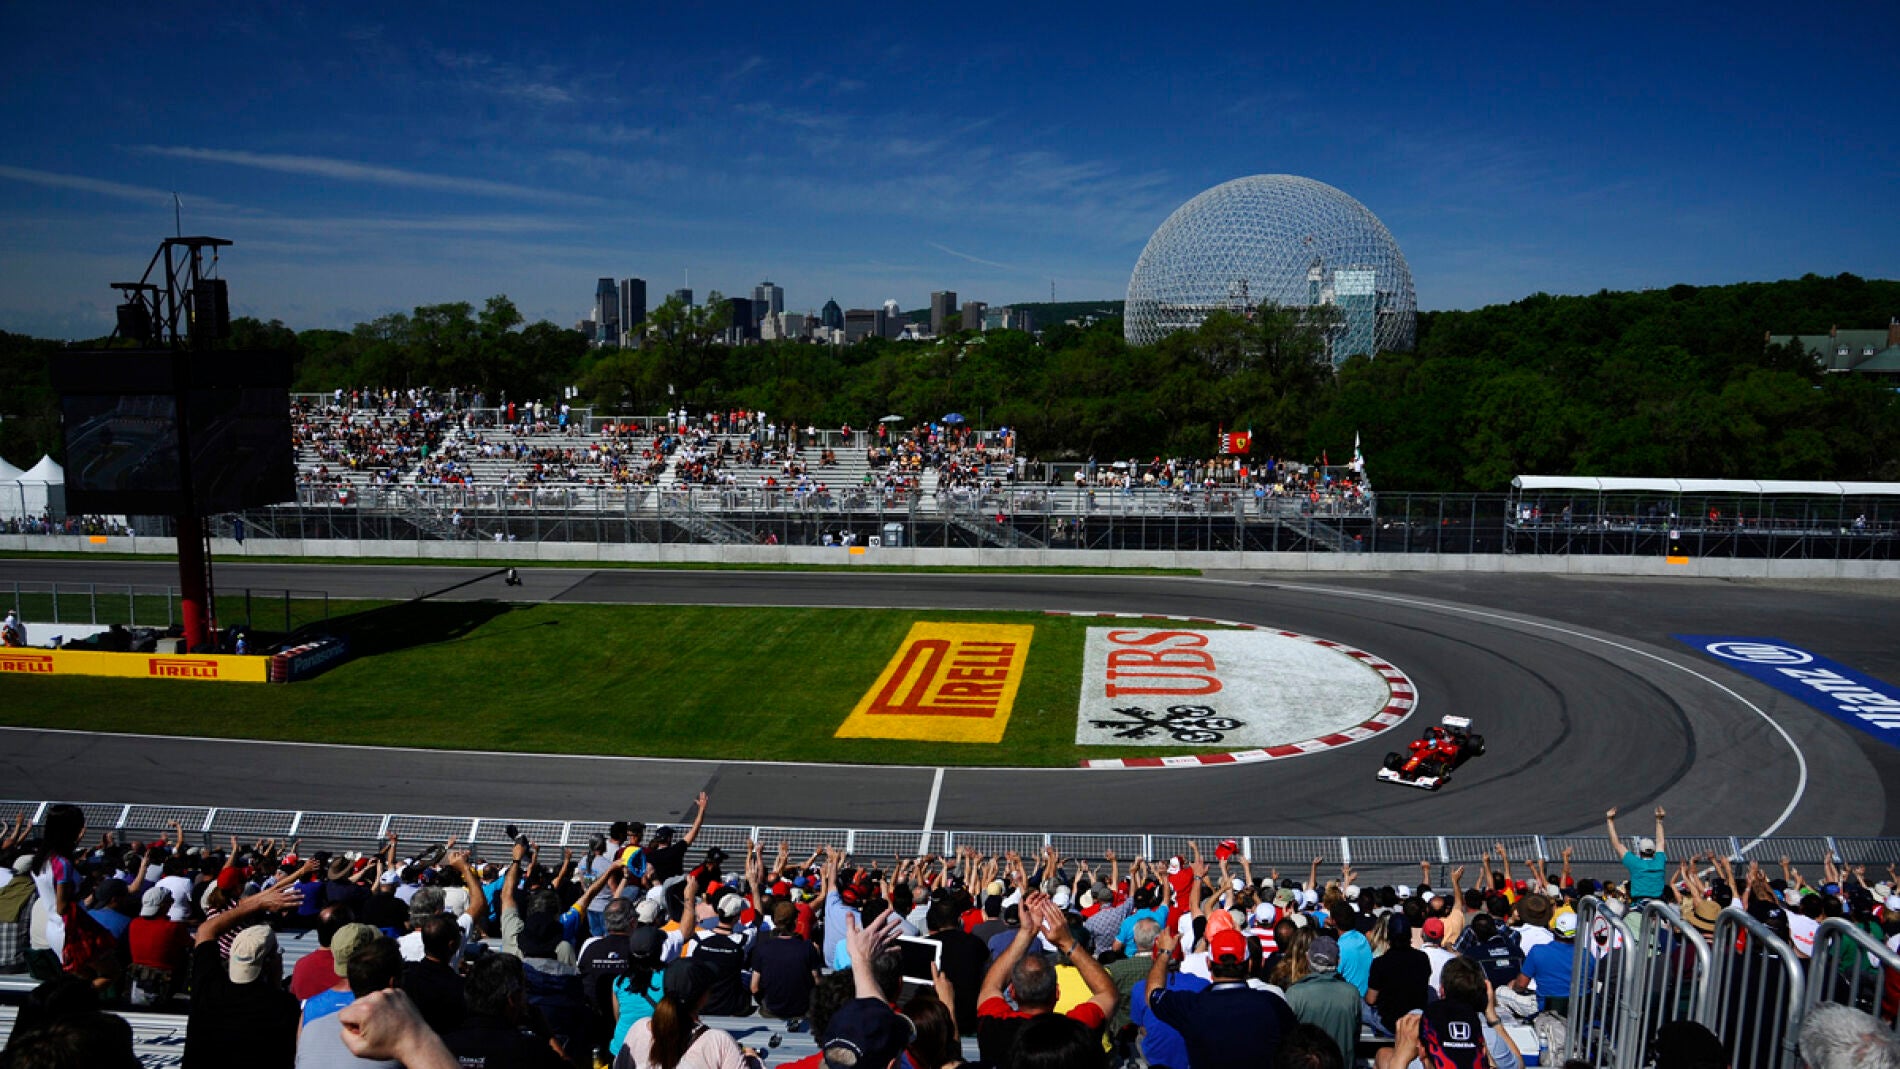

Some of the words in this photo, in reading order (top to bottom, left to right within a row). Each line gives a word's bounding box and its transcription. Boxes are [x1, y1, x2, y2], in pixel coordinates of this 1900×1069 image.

[0, 654, 53, 673] RELLI
[149, 658, 218, 678] PIRELLI
[294, 642, 345, 673] Panasonic
[865, 639, 1016, 718] PIRELLI
[1105, 630, 1223, 697] UBS
[1776, 667, 1900, 729] llianz
